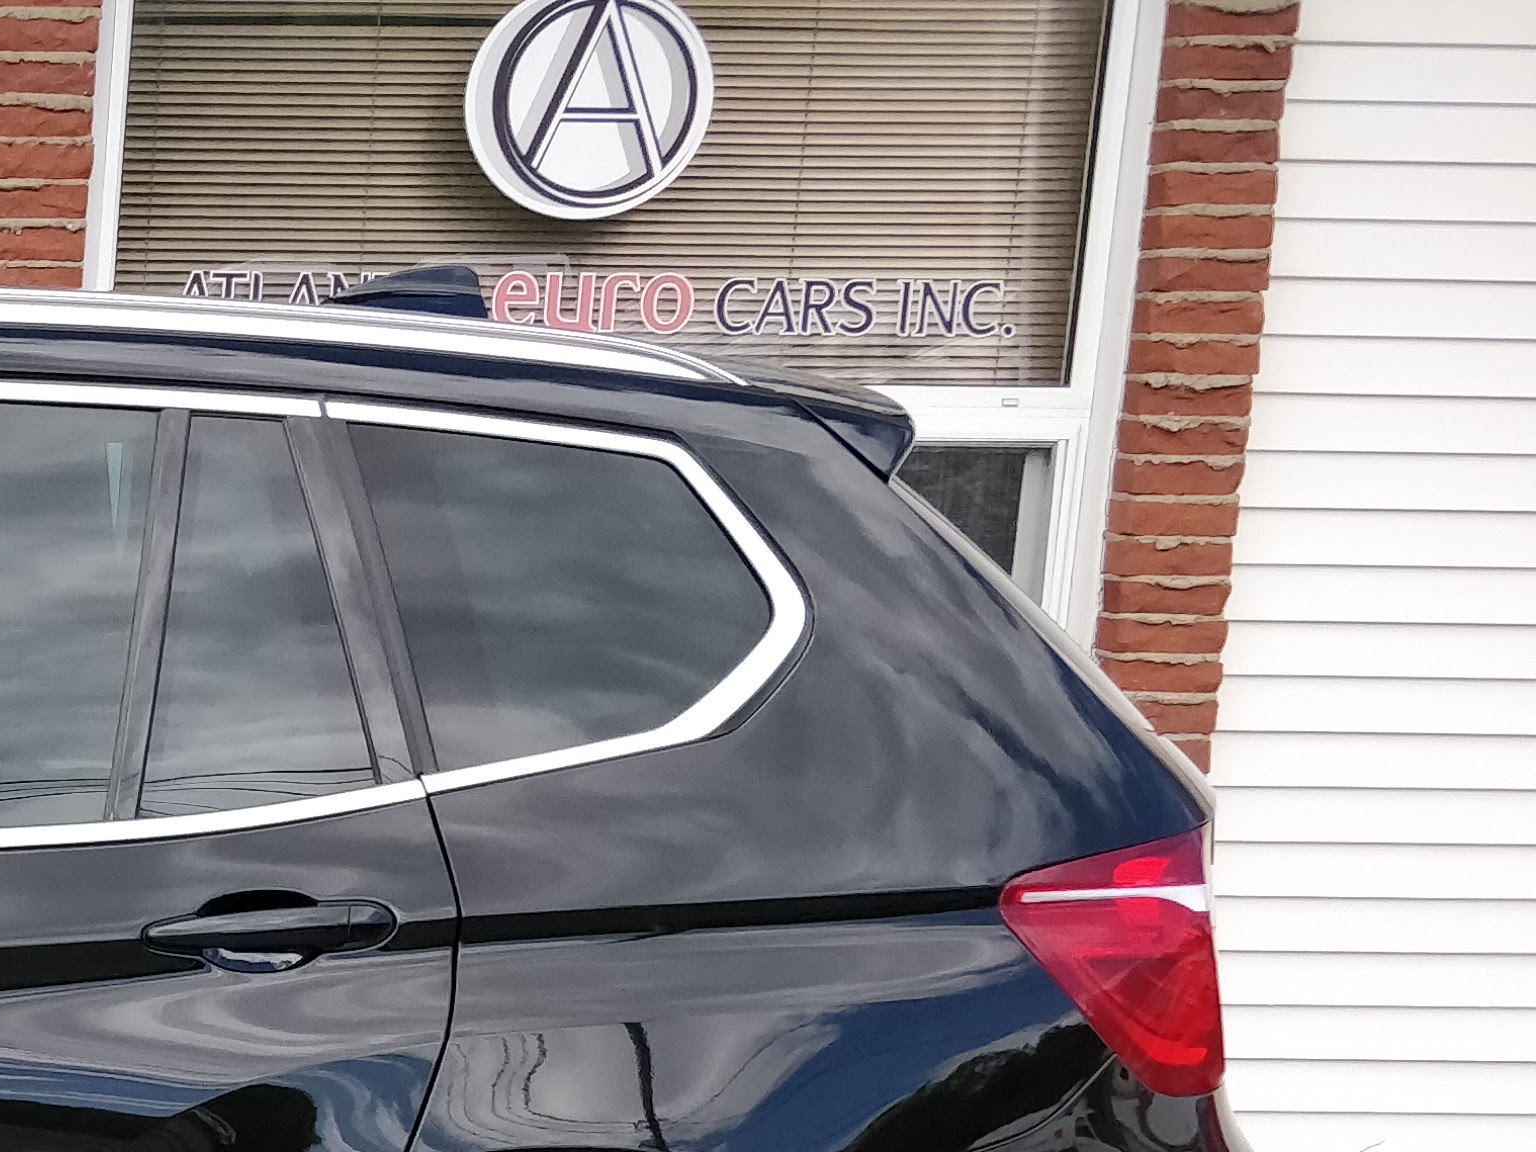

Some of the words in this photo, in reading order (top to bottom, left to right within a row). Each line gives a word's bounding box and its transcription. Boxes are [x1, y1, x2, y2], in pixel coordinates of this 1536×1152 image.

[491, 270, 695, 334] euro
[714, 277, 877, 336] CARS
[895, 279, 1017, 337] INC.
